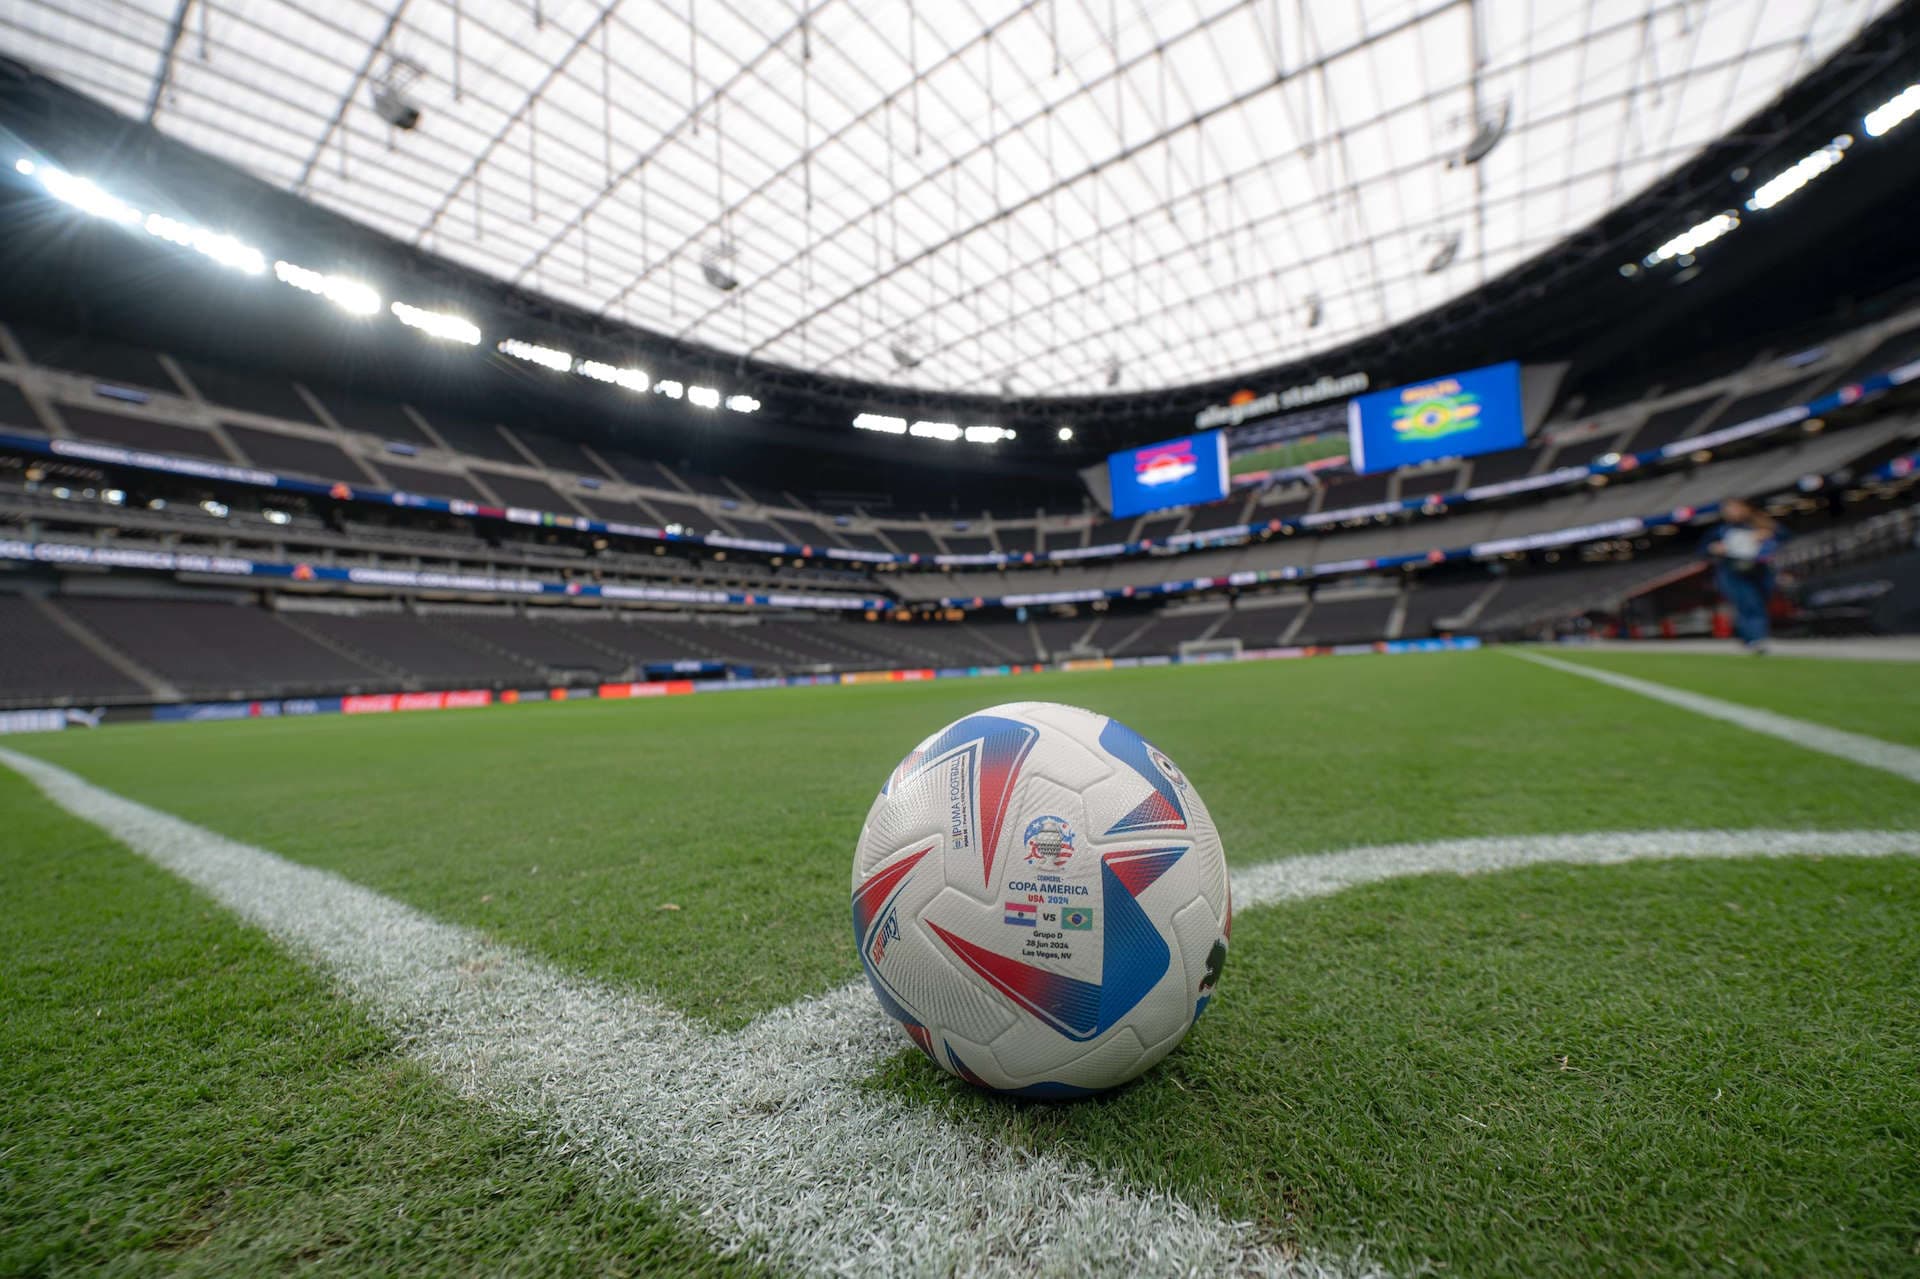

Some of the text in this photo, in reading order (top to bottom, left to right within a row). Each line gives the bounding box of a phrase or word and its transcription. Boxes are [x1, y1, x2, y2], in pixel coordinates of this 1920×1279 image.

[950, 757, 962, 835] PUMA FOOTBALL
[1008, 881, 1089, 896] COPA AMERICA
[1028, 894, 1069, 905] USA 2024
[1033, 930, 1063, 940] Grupo D
[1026, 939, 1036, 947] 28
[1050, 941, 1069, 950] 2024
[1022, 948, 1072, 960] Las Vegas, NV
